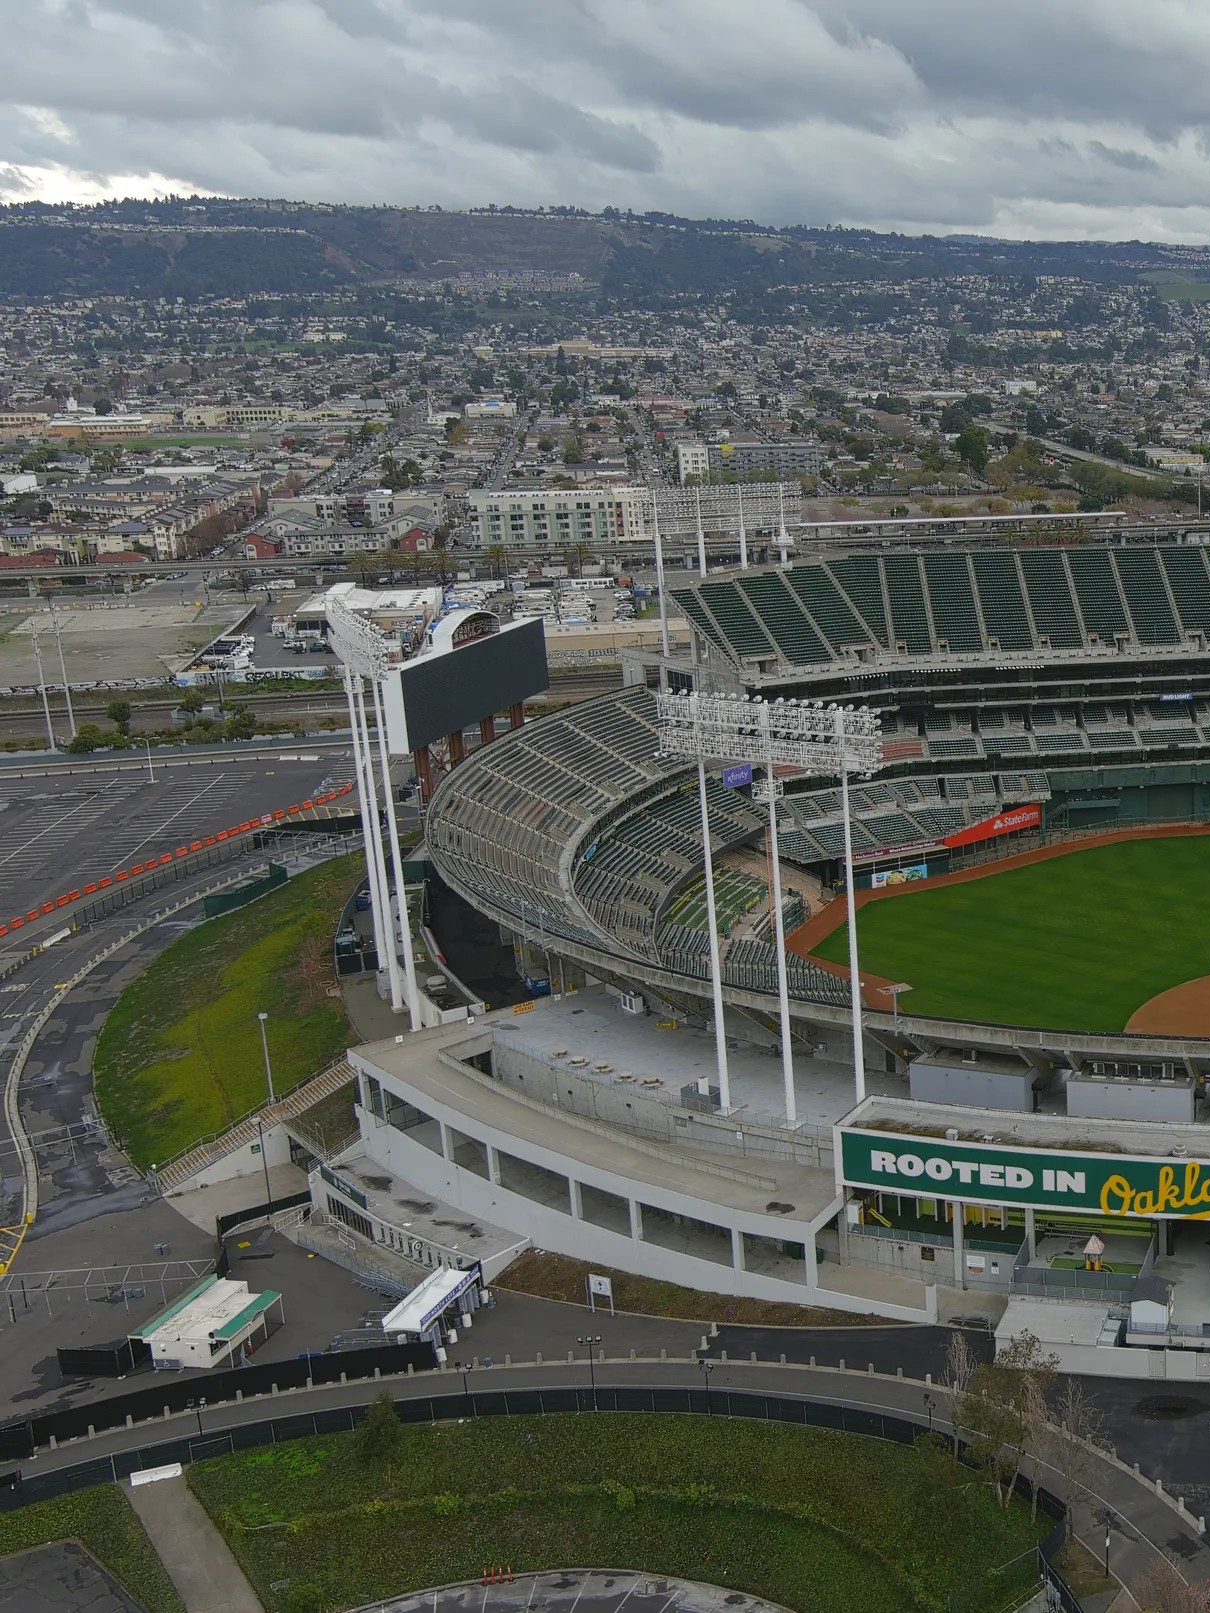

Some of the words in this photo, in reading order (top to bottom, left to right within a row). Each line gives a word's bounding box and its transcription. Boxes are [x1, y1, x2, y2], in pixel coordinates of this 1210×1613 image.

[727, 770, 749, 783] xfinity
[870, 1150, 1034, 1189] ROOTED
[1042, 1169, 1086, 1194] IN
